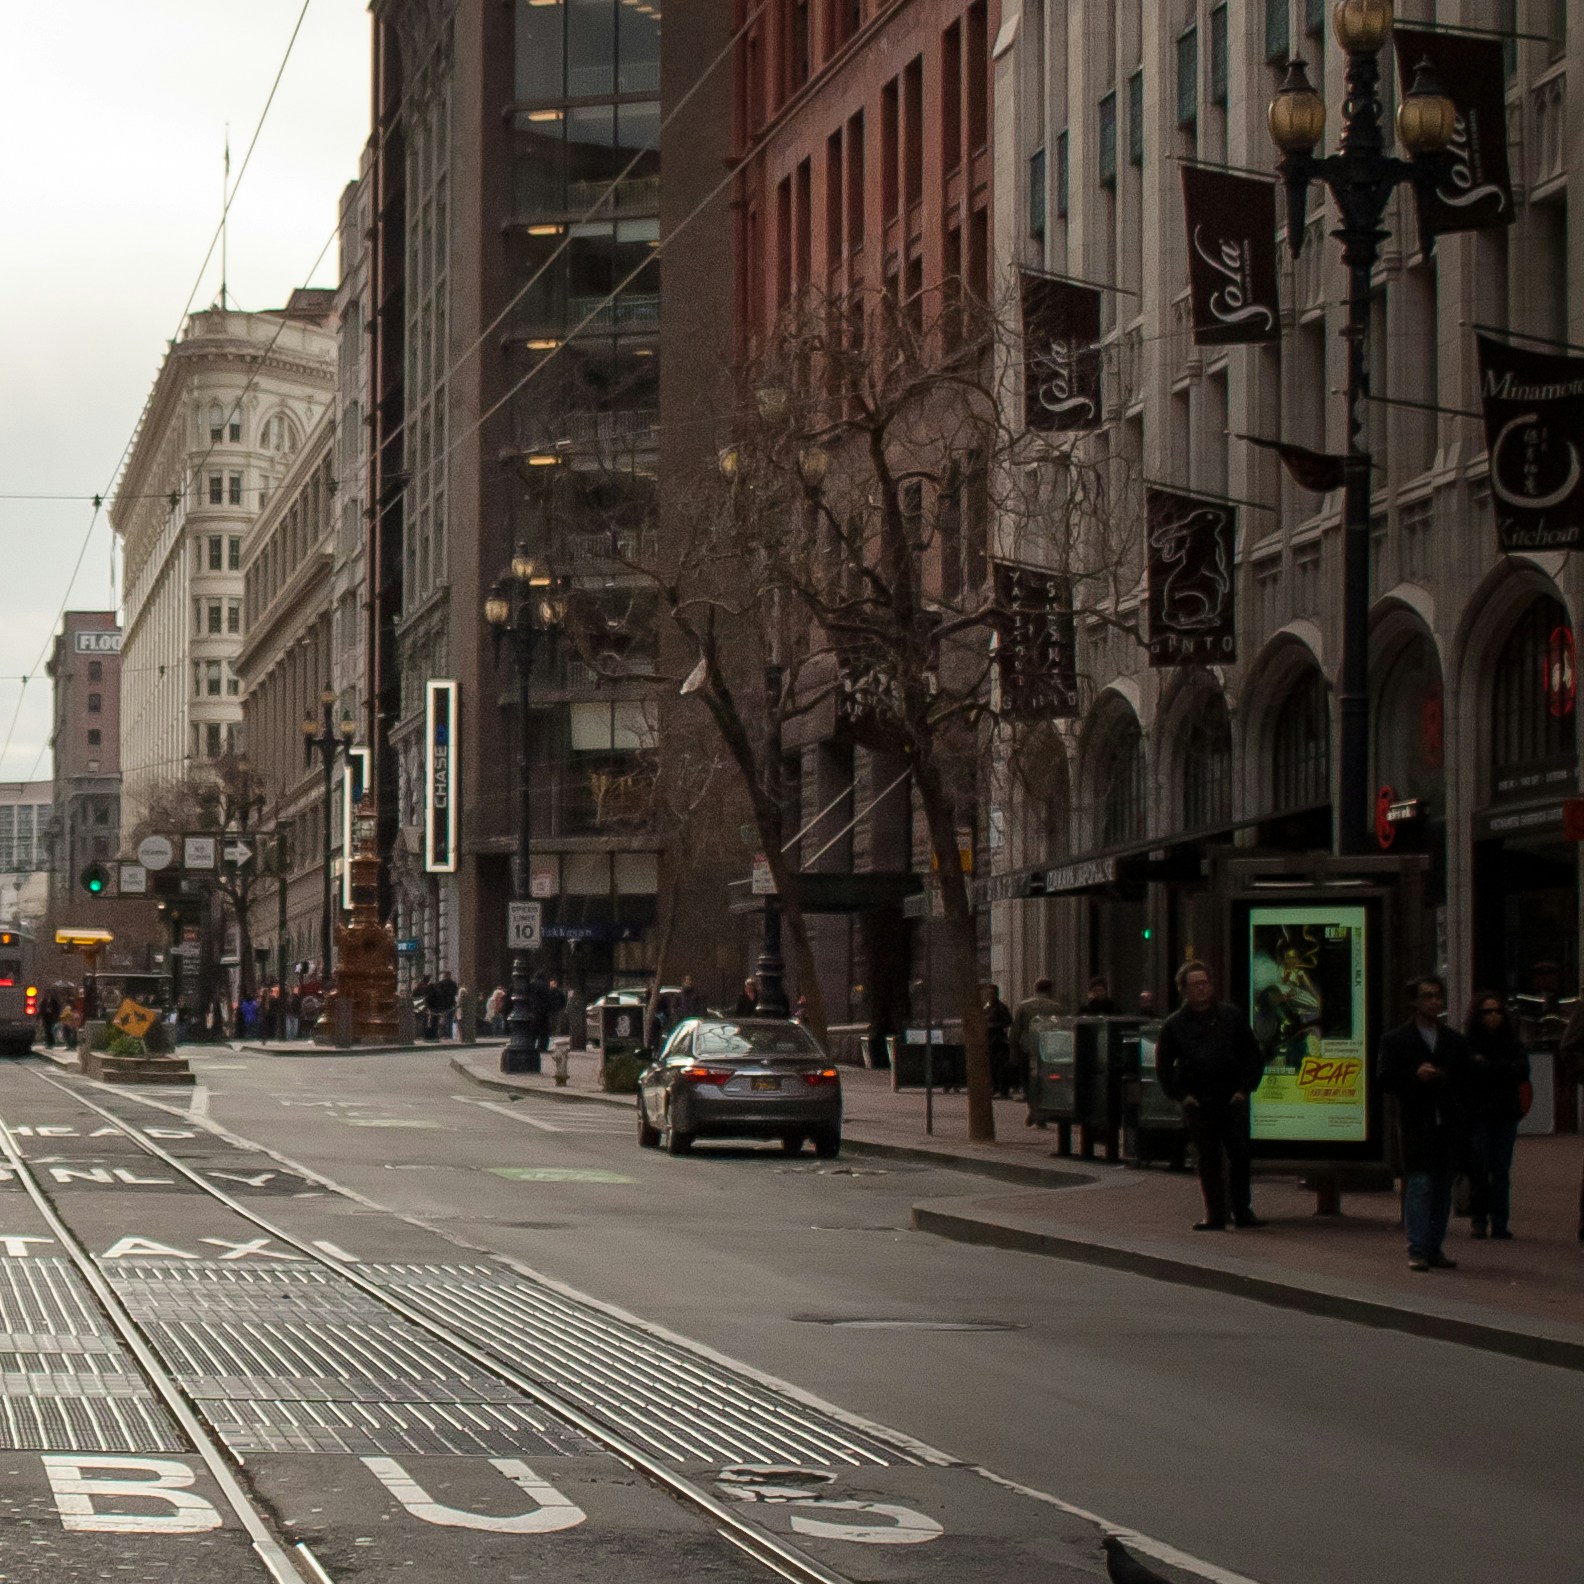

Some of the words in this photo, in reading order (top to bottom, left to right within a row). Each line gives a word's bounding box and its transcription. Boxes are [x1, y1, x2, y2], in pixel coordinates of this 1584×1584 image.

[1194, 224, 1273, 332] Sola
[1029, 325, 1096, 420] Sola
[435, 745, 448, 809] CHASE
[515, 924, 534, 939] 10
[1299, 1059, 1359, 1086] BCAF
[42, 1454, 945, 1545] BUS
